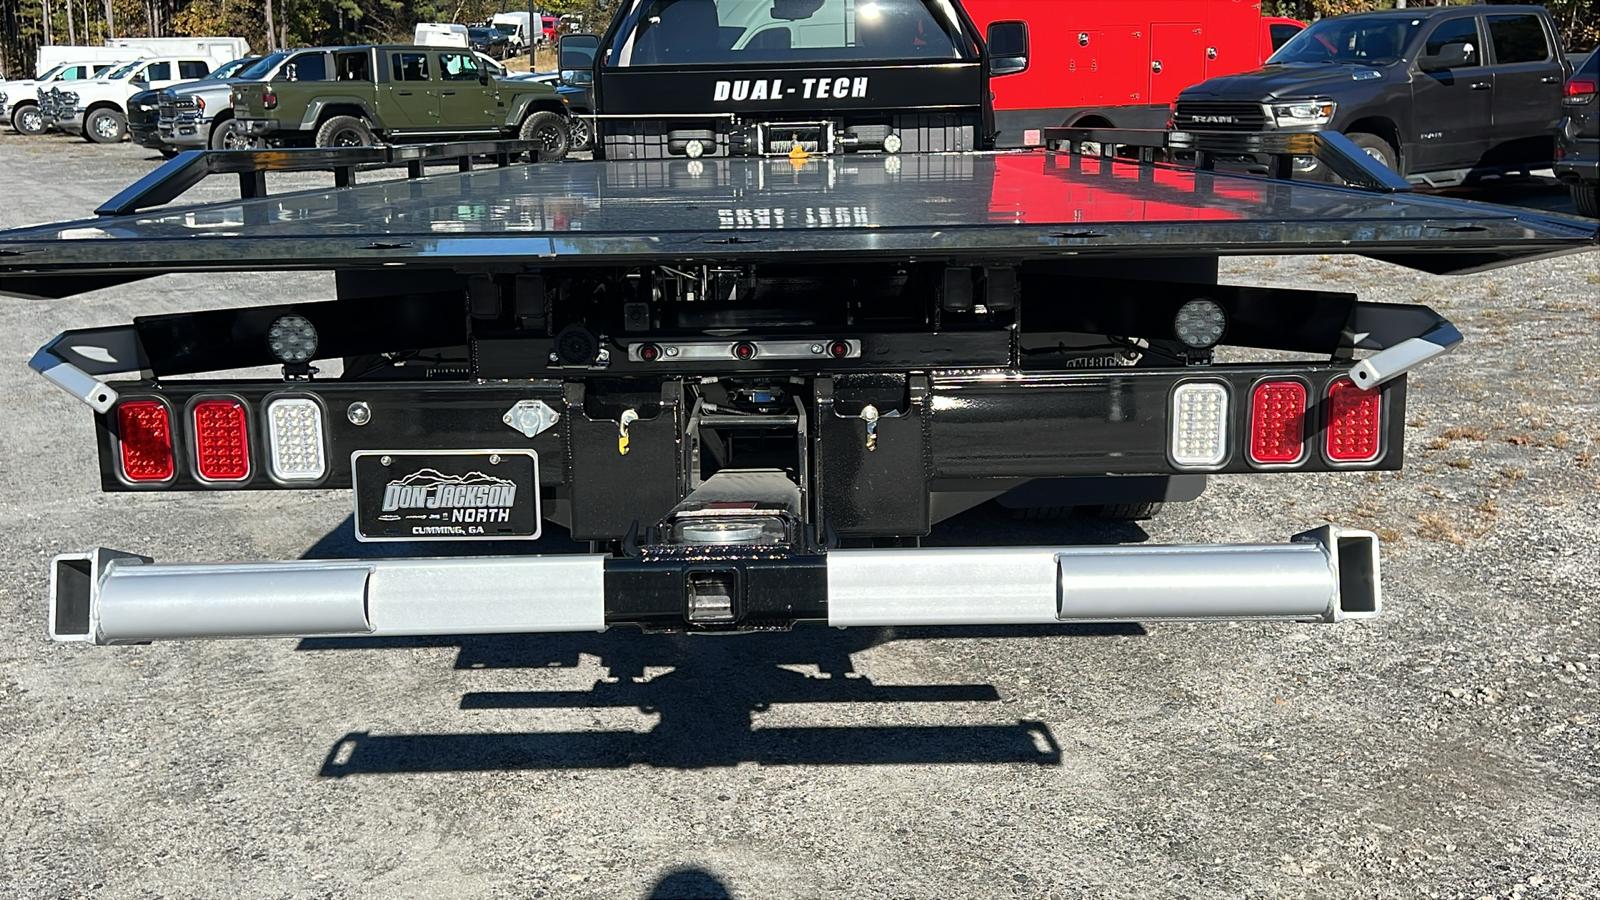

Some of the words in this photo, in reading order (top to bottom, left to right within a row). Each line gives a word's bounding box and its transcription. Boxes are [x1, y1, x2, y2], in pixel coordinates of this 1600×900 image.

[713, 77, 868, 101] DUAL-TECH
[1192, 115, 1232, 123] RAM
[381, 485, 427, 512] DON
[426, 484, 517, 509] JACKSON
[451, 508, 510, 523] NORTH
[412, 526, 466, 535] CUMMING,
[468, 526, 485, 534] GA
